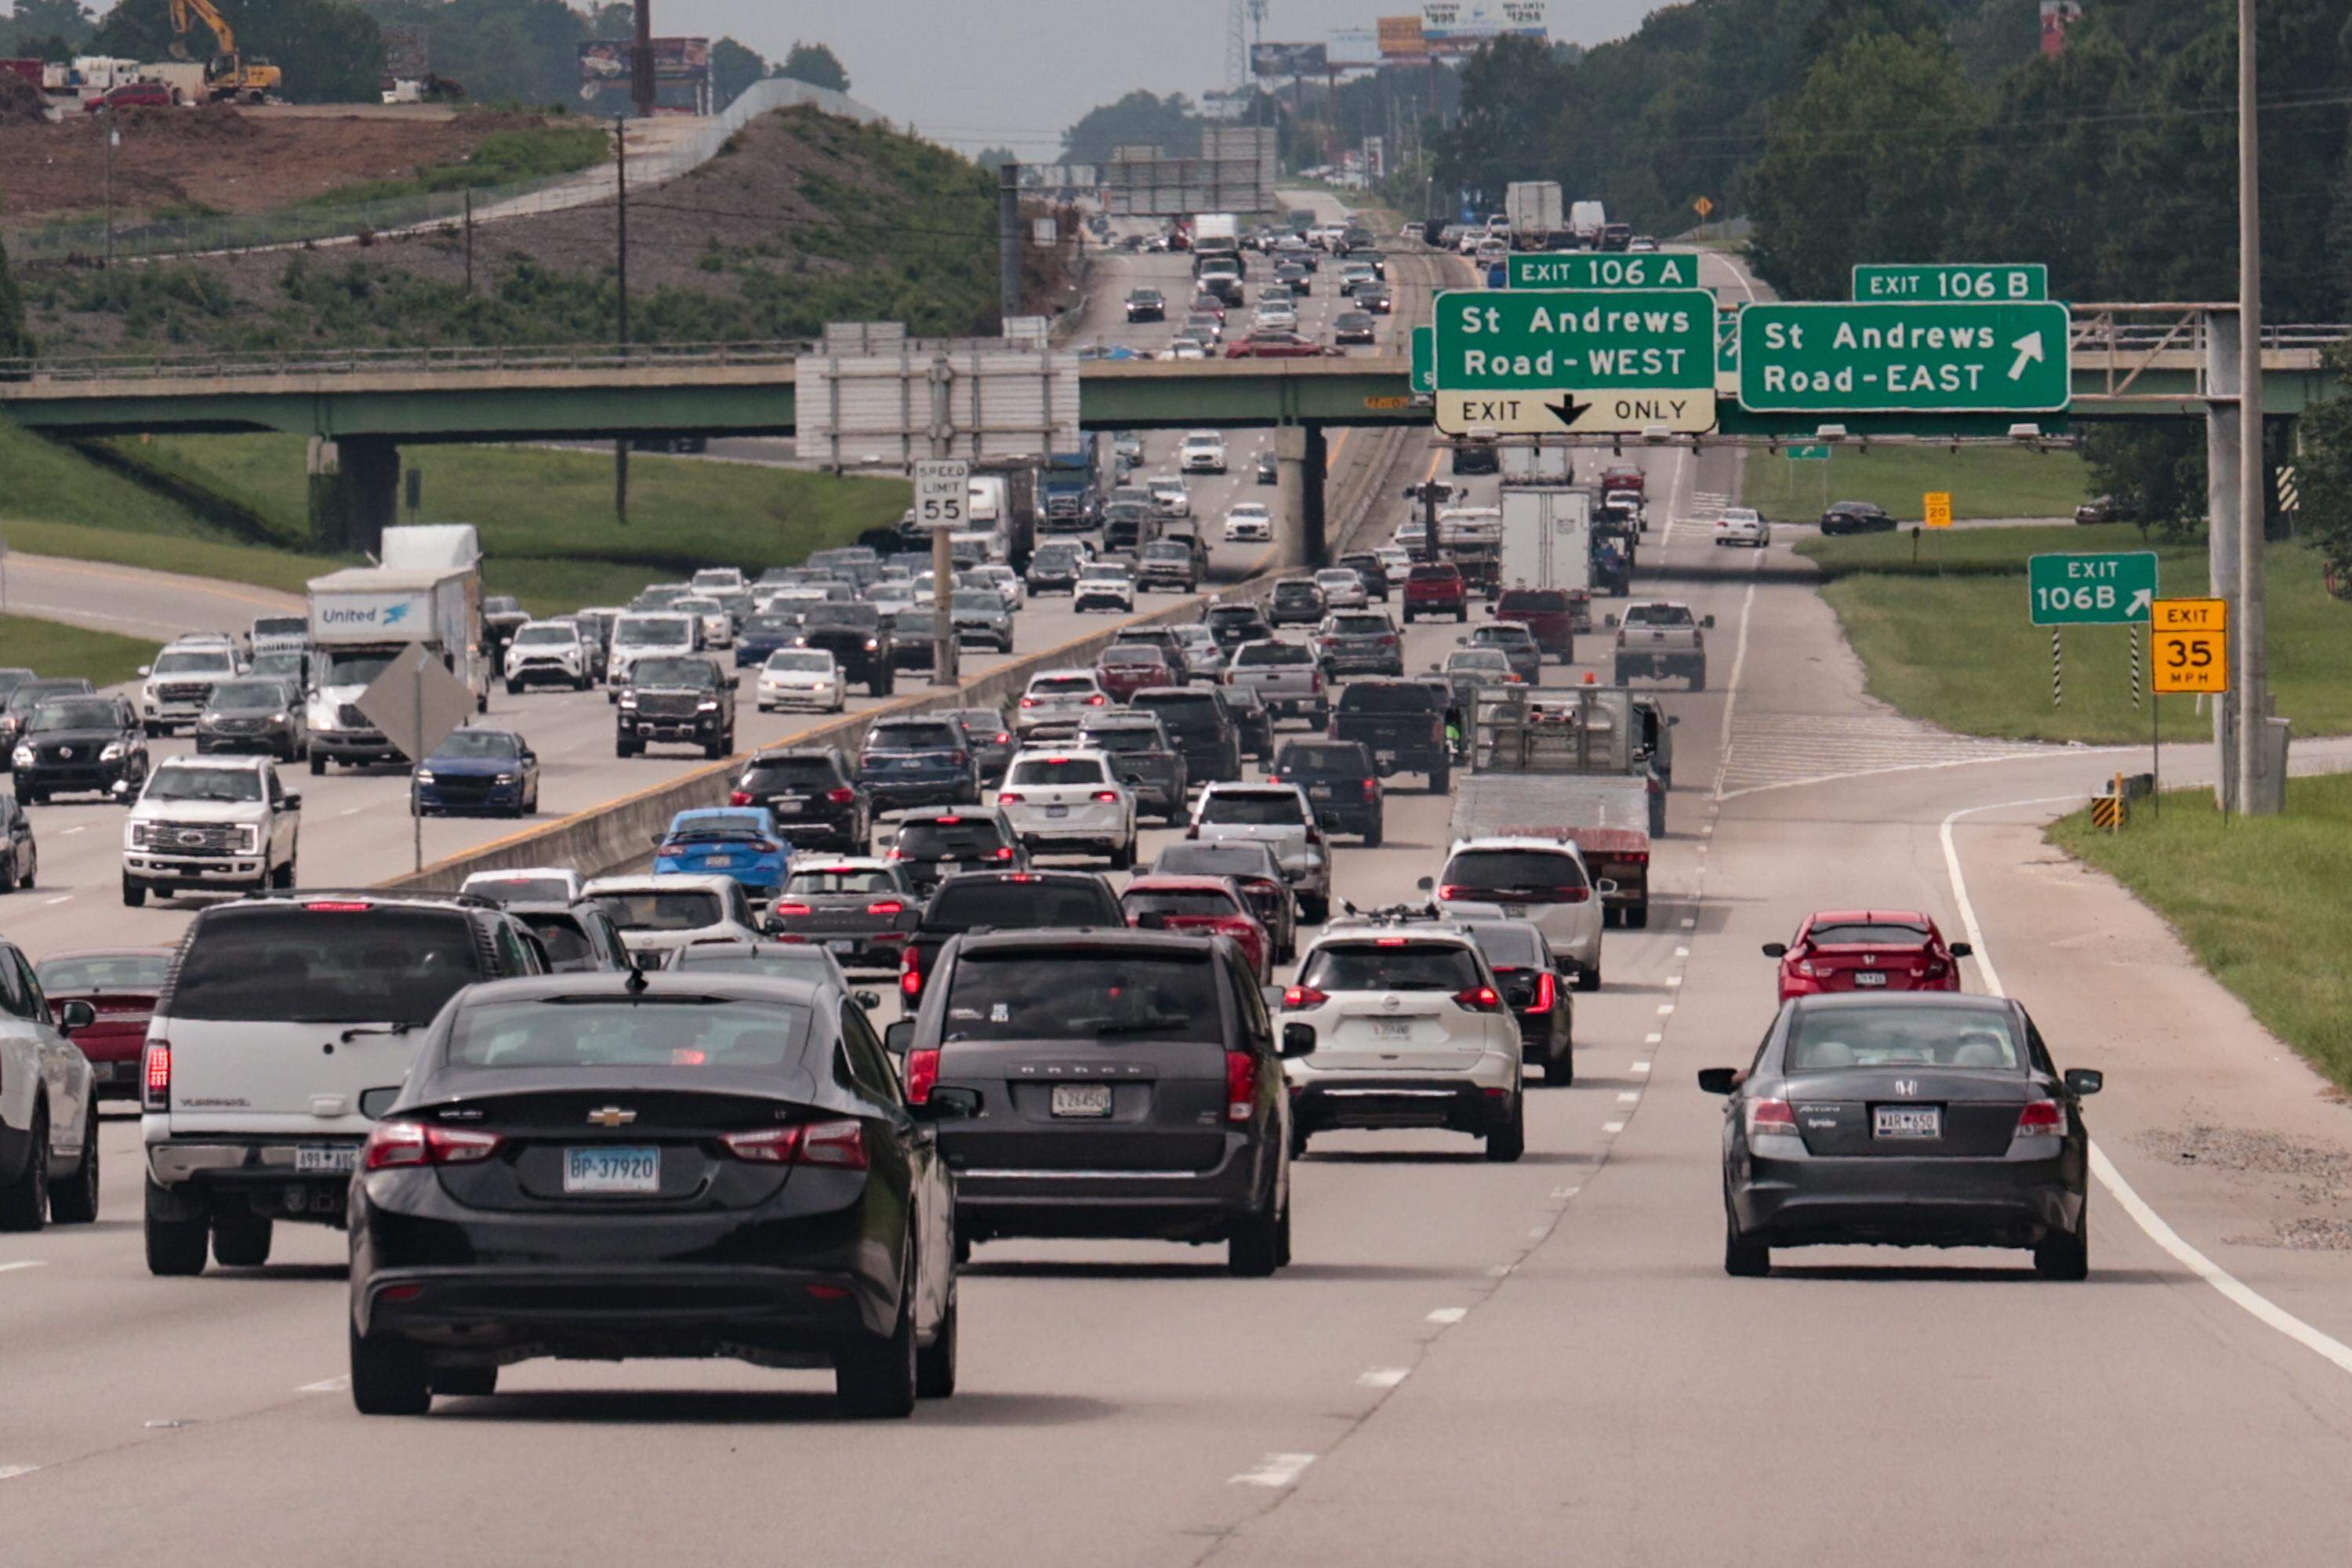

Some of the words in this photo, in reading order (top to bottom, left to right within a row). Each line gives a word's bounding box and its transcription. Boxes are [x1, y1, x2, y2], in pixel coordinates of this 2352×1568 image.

[1522, 263, 1571, 281] EXIT
[1589, 260, 1645, 285] 106
[1659, 260, 1682, 285] A
[1871, 276, 1921, 294] EXIT
[1938, 272, 1995, 297] 106
[2008, 272, 2029, 297] B
[1461, 307, 1500, 333] St
[1530, 307, 1690, 333] Andrews
[1765, 322, 1803, 350] St
[1832, 321, 1995, 350] Andrews
[1463, 401, 1521, 421] EXIT
[1615, 400, 1687, 420] ONLY
[920, 466, 965, 477] SPEED
[924, 482, 961, 493] LIMIT
[925, 499, 960, 519] 55
[2067, 561, 2119, 579] EXIT
[2038, 586, 2116, 611] 106B
[323, 608, 376, 624] United
[2168, 608, 2209, 623] EXIT
[2167, 640, 2212, 667] 35
[2171, 673, 2209, 683] MPH
